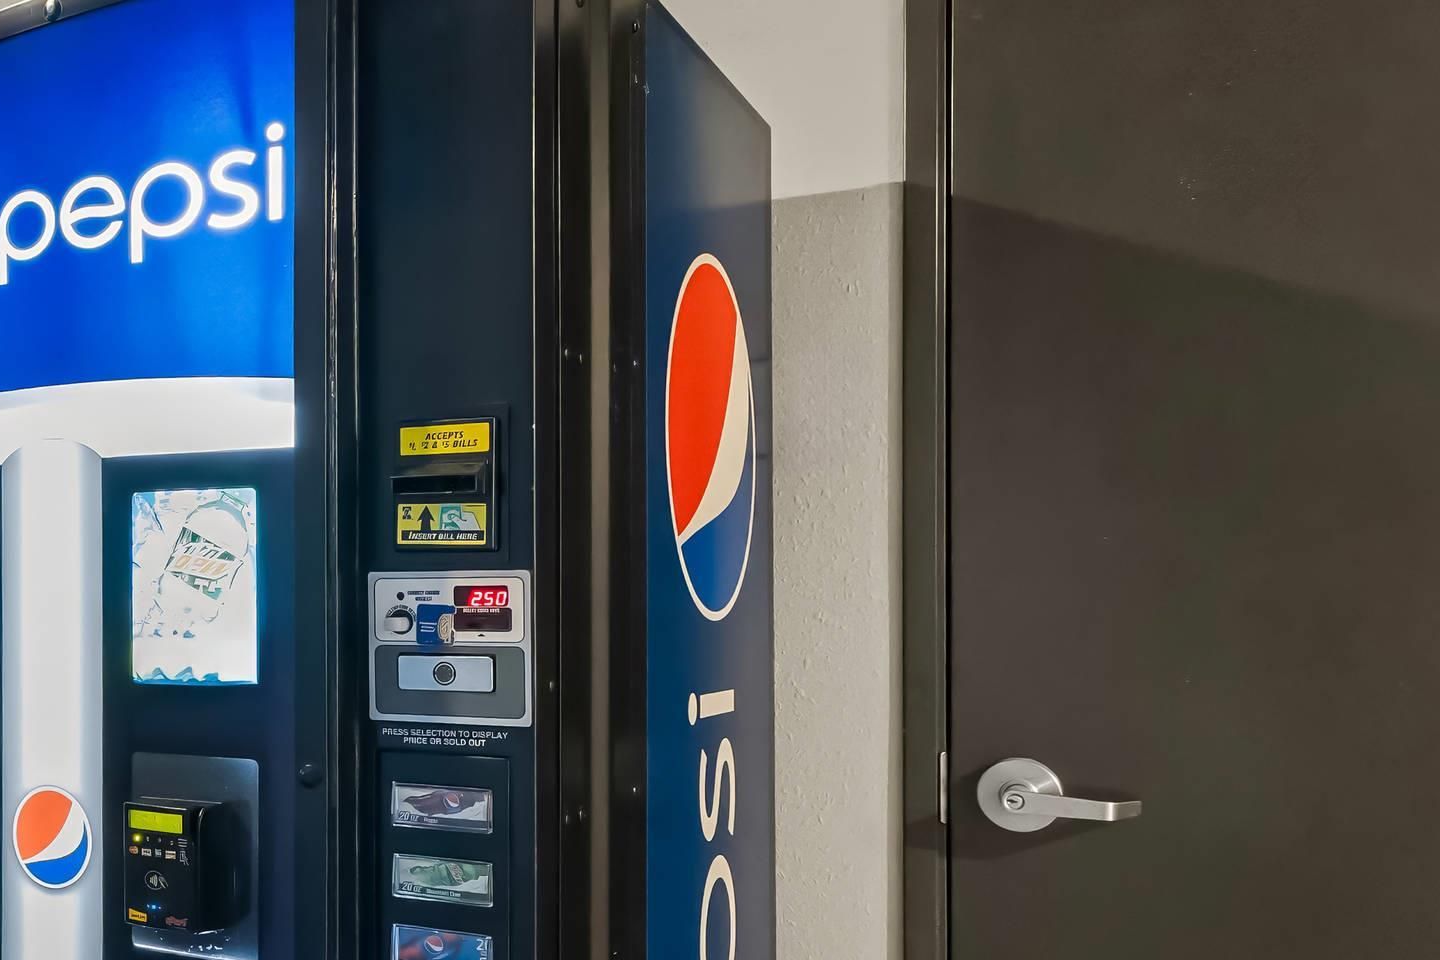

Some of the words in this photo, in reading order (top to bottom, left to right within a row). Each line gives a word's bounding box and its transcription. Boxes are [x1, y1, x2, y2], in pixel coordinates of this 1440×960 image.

[425, 430, 465, 441] ACCEPTS
[452, 438, 479, 448] BILLS
[408, 531, 437, 541] INSERT
[438, 532, 455, 541] BILL
[456, 532, 478, 541] HERE
[382, 727, 409, 736] PRESS
[410, 728, 457, 738] SELECTION
[459, 730, 470, 738] TO
[471, 731, 509, 740] DISPLAY
[403, 736, 428, 745] PRICE
[429, 737, 442, 745] OR
[443, 738, 467, 747] SOLD
[468, 739, 487, 747] OUT
[398, 810, 410, 821] 20
[401, 881, 413, 891] 20
